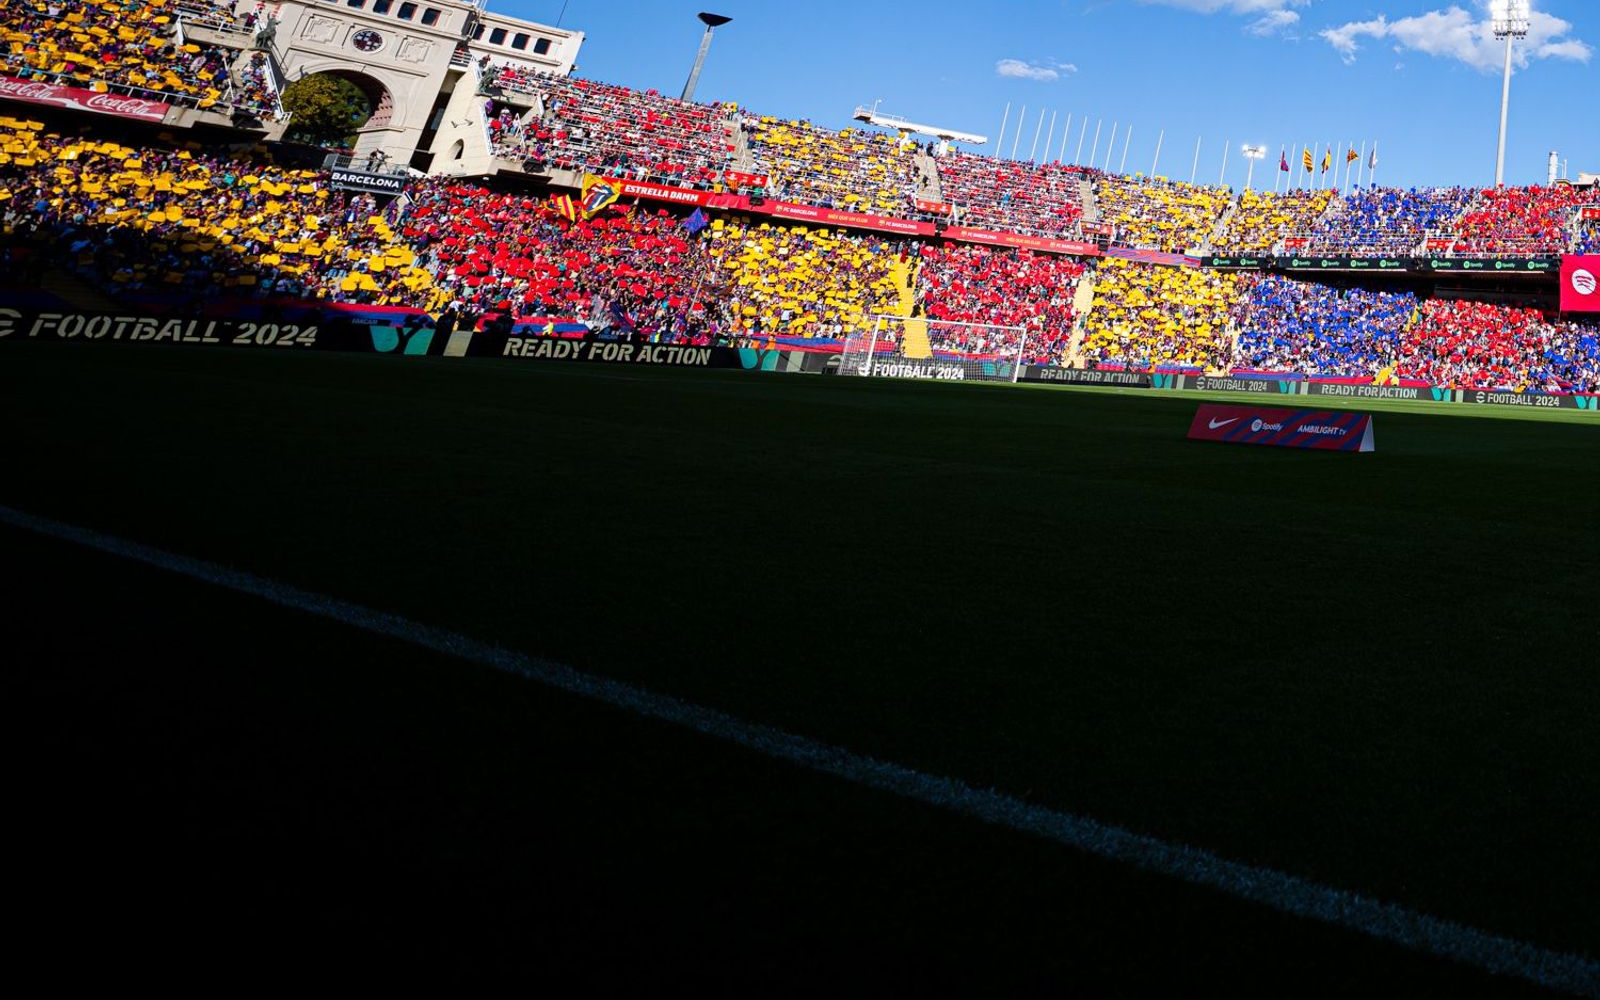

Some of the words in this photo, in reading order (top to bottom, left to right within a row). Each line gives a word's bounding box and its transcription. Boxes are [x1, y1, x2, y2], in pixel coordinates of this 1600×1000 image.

[331, 172, 400, 189] BARCELONA
[624, 184, 669, 198] ESTRELLA
[669, 191, 699, 202] DAMM
[789, 207, 818, 216] BARCELONA
[29, 312, 221, 343] FOOTBALL
[231, 322, 320, 347] 2024
[502, 337, 587, 359] READY
[587, 342, 635, 363] FOR
[635, 345, 712, 366] ACTION
[872, 363, 936, 379] FOOTBALL
[936, 366, 965, 380] 2024
[1040, 368, 1079, 381] READY
[1081, 371, 1101, 382] FOR
[1103, 373, 1140, 384] ACTION
[1206, 378, 1246, 391] FOOTBALL
[1248, 381, 1268, 392] 2024
[1321, 384, 1356, 397] READY
[1358, 386, 1379, 398] FOR
[1381, 387, 1418, 399] ACTION
[1487, 393, 1533, 406] FOOTBALL
[1535, 395, 1560, 407] 2024
[1297, 424, 1339, 435] AMBILIGHT
